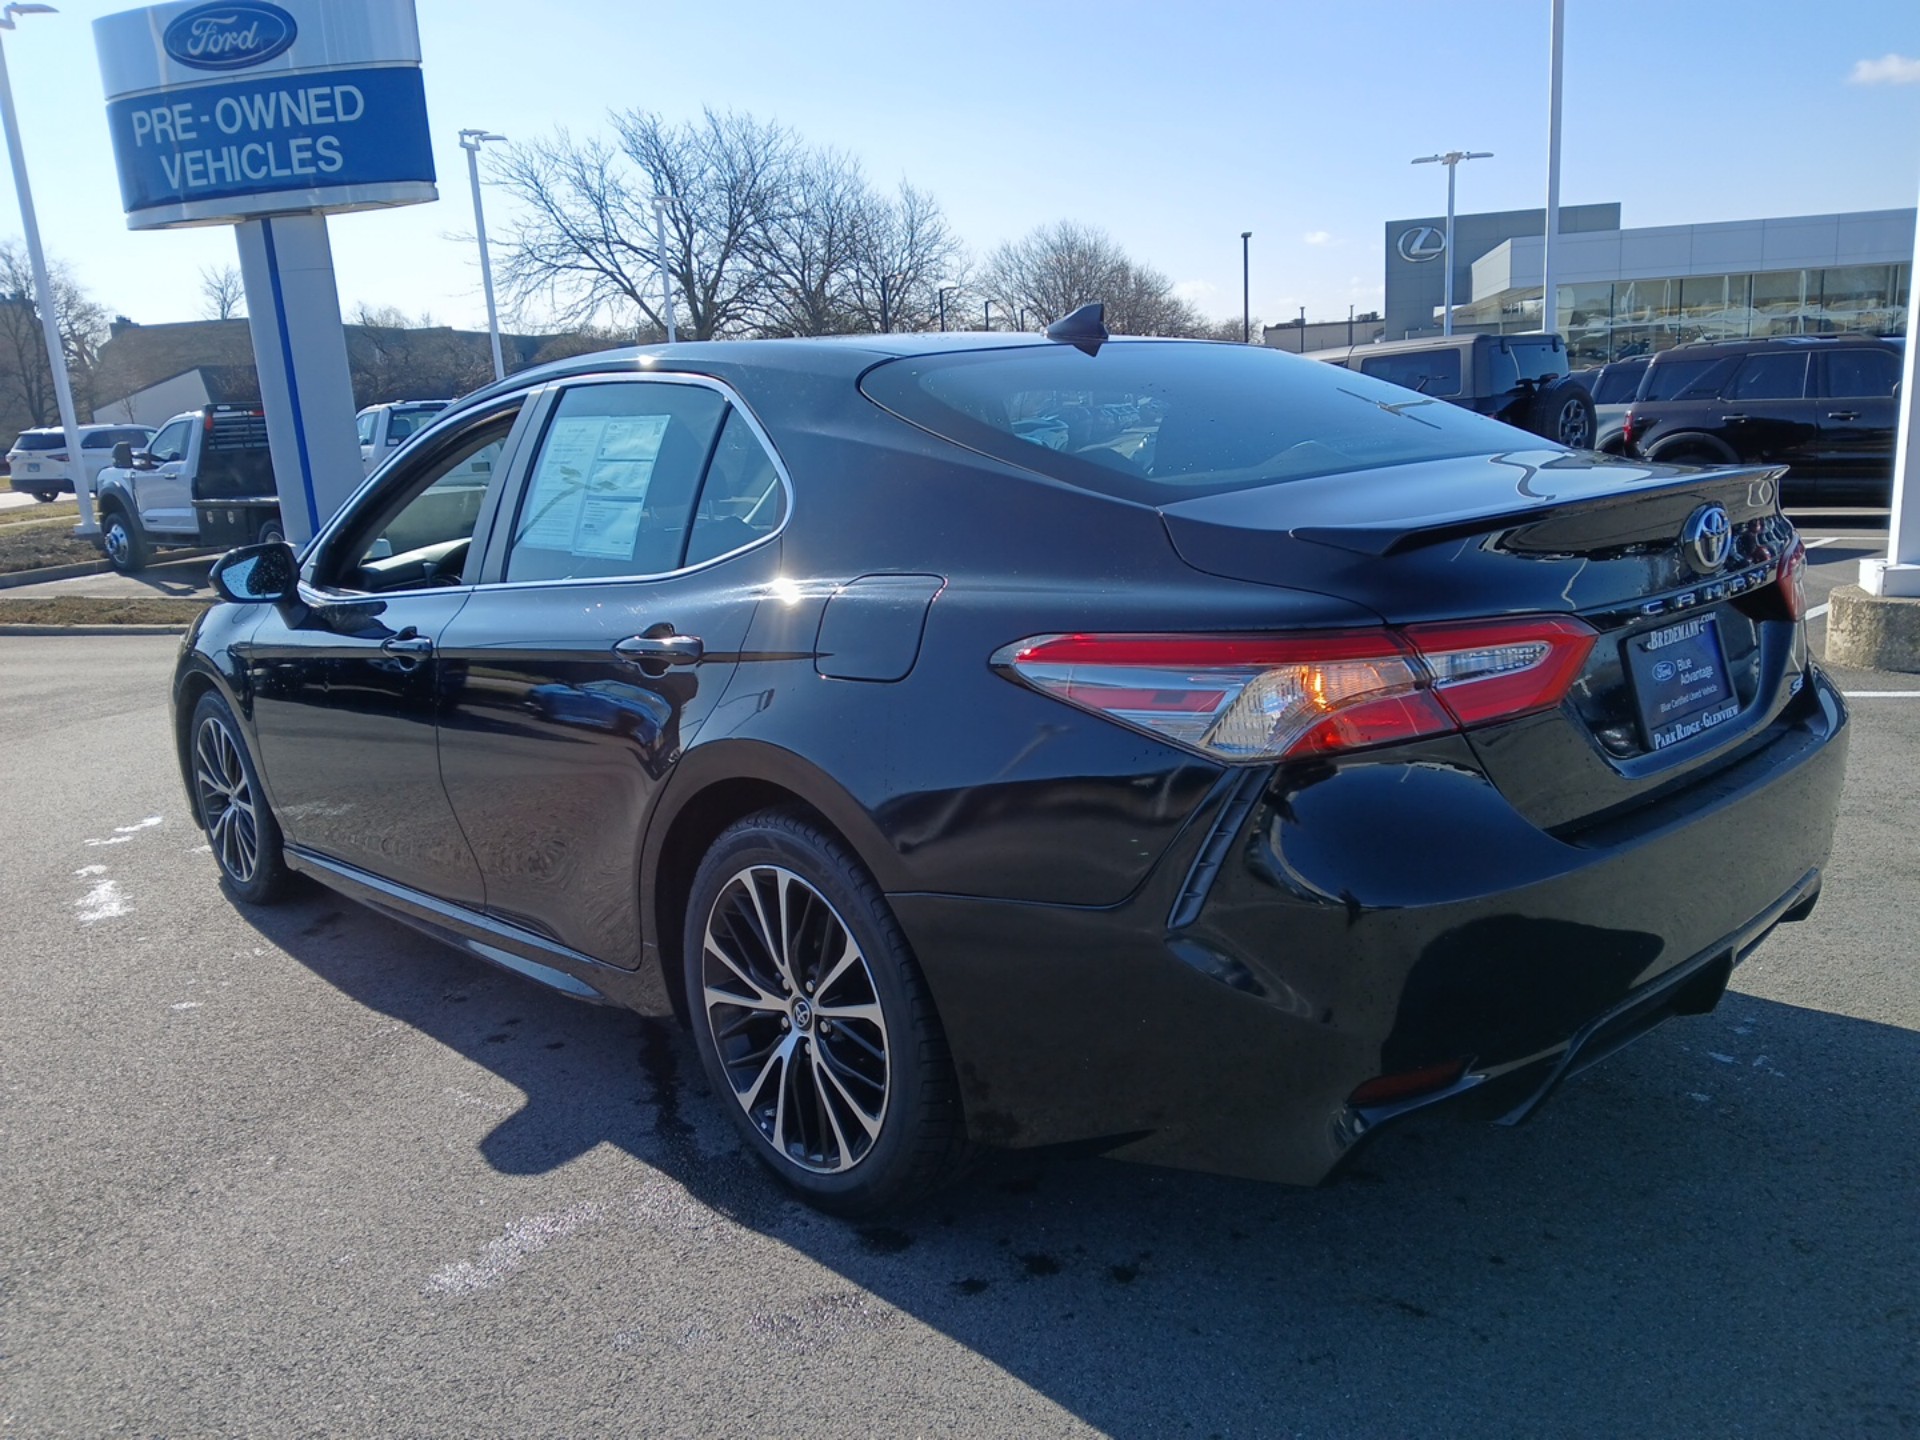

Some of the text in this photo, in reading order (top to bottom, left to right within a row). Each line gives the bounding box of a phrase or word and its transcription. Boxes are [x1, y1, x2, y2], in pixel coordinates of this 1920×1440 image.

[186, 15, 260, 56] Ford
[160, 135, 344, 189] VEHICLES
[1641, 568, 1767, 615] CAMRY
[1677, 658, 1692, 671] Blue
[1680, 665, 1714, 685] Advantage
